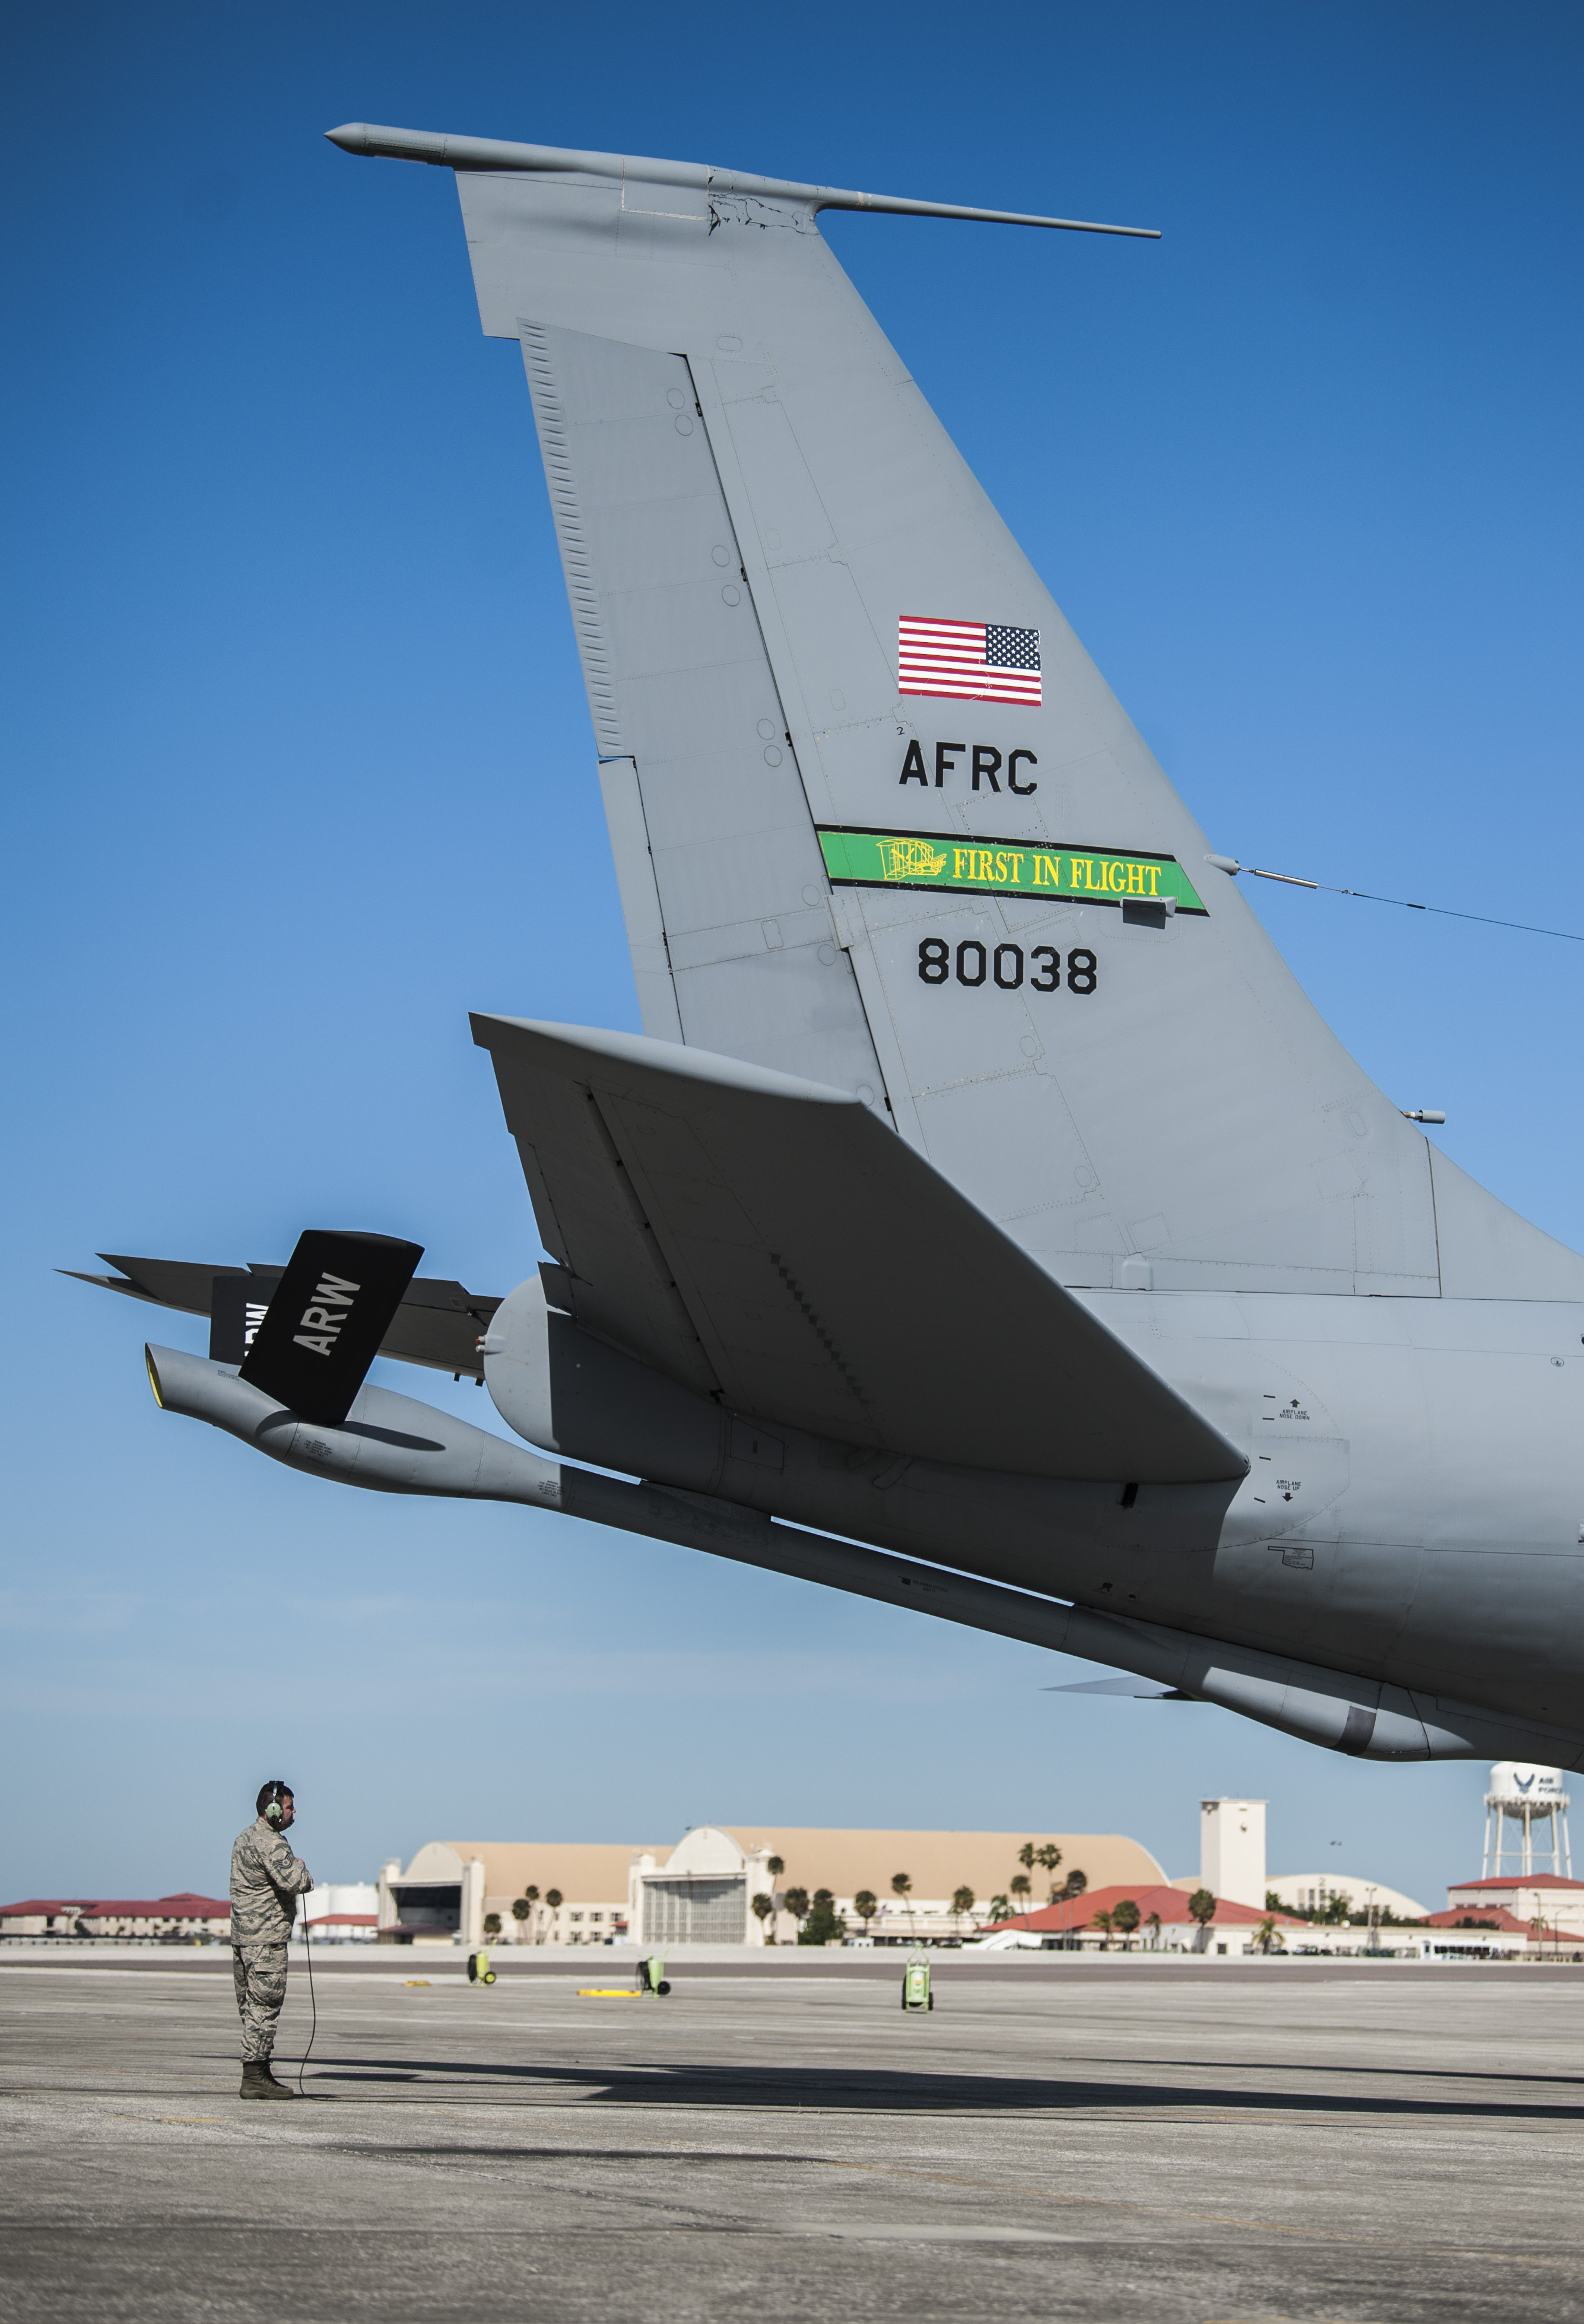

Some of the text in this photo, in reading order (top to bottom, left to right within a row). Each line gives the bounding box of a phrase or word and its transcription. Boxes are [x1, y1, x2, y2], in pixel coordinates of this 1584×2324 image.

[899, 739, 1037, 795] AFRC
[953, 848, 1161, 896] FIRST IN FLIGHT
[918, 938, 1097, 995] 80038
[293, 1272, 361, 1356] ARW
